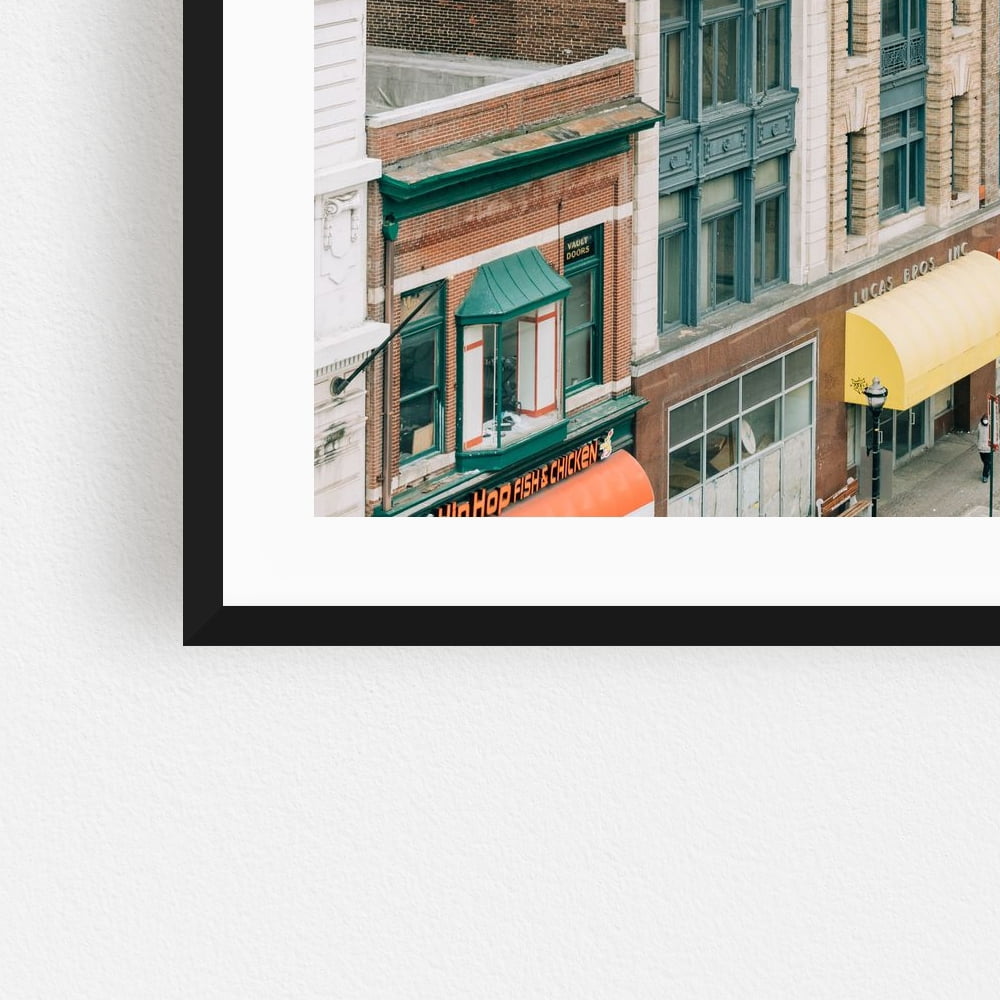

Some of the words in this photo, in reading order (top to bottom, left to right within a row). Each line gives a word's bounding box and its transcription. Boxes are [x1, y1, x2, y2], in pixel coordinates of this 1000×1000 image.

[566, 245, 590, 260] DOORS
[567, 235, 589, 250] VAULT
[853, 276, 894, 307] LUCAS
[903, 256, 936, 284] BROS
[948, 242, 969, 263] INC
[514, 478, 540, 503] FISH
[541, 464, 548, 488] &
